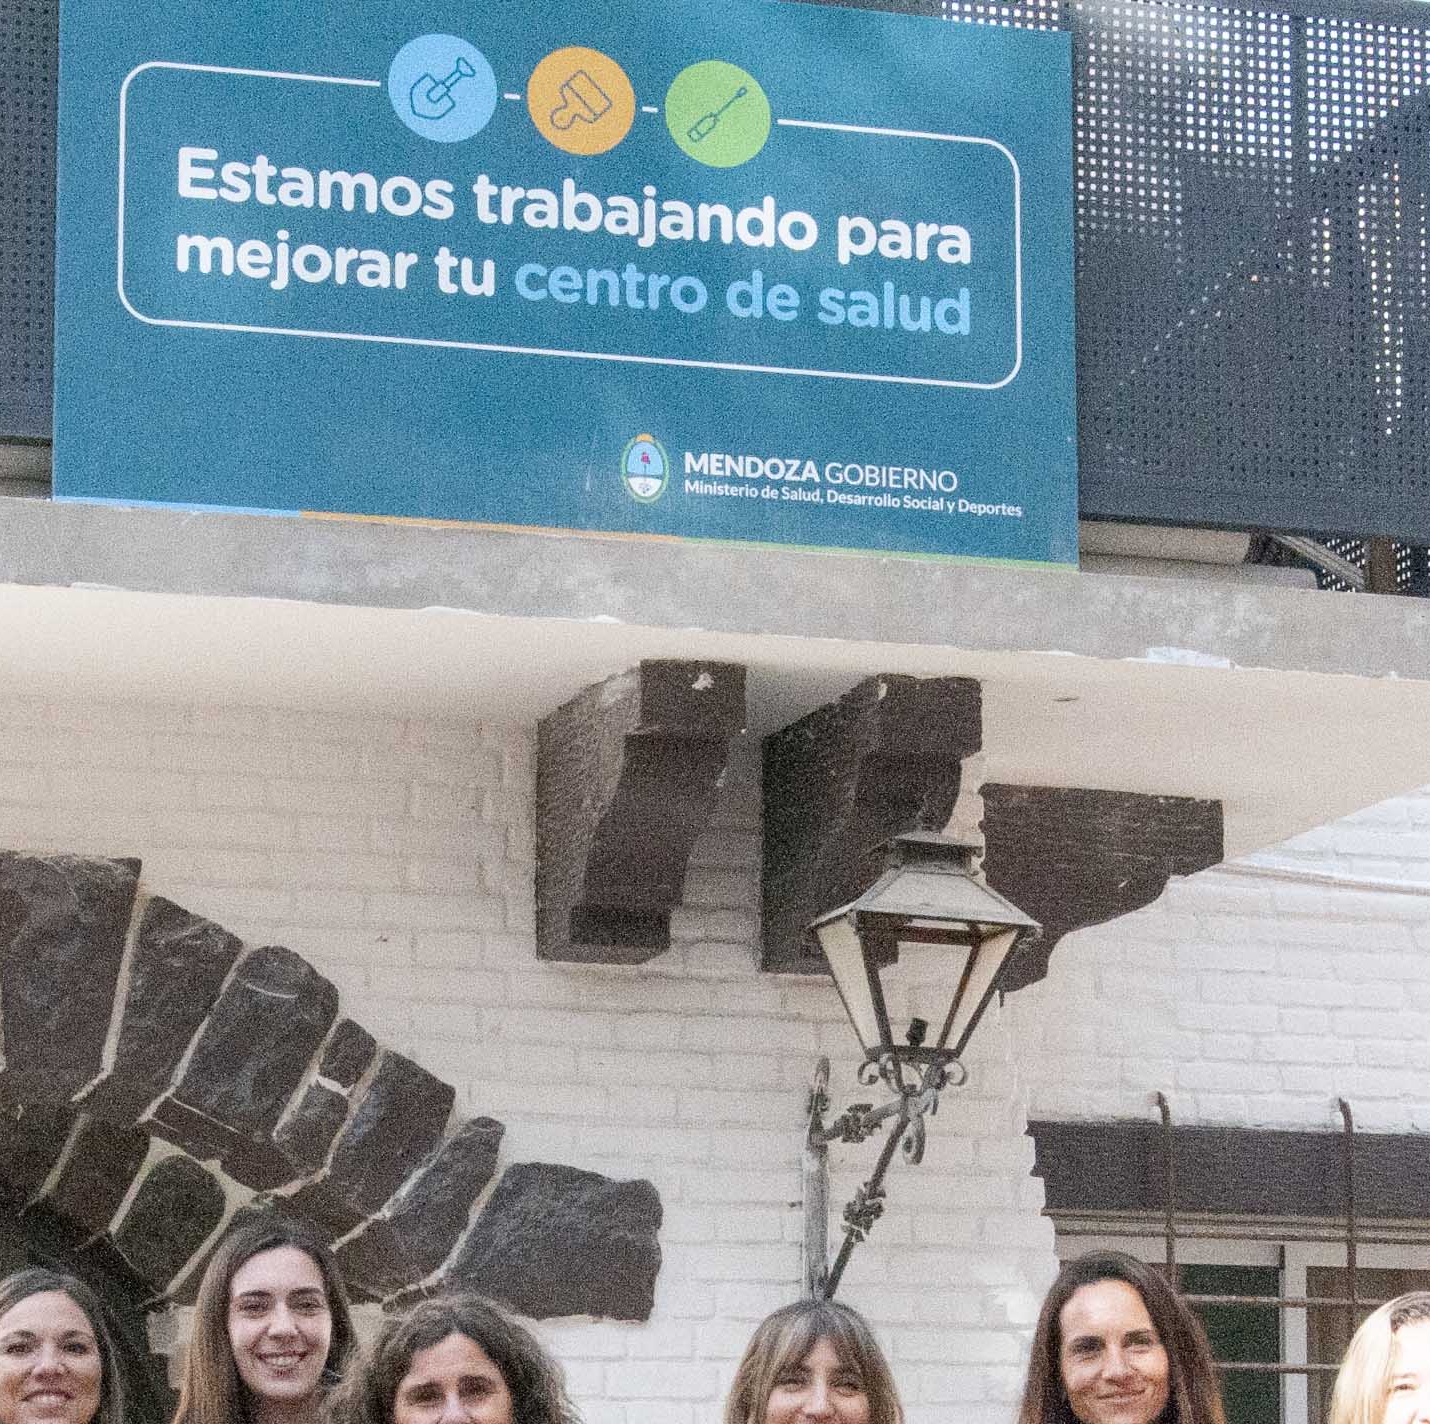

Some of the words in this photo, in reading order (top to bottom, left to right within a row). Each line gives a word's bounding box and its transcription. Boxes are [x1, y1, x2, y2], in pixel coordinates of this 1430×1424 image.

[177, 146, 455, 220] Estamos
[473, 174, 819, 248] trabajando
[837, 215, 972, 265] para
[176, 229, 418, 290] mejorar
[435, 246, 495, 297] tu
[515, 263, 708, 314] centro
[726, 269, 800, 321] de
[817, 281, 972, 336] salud
[684, 452, 821, 483] MENDOZA
[824, 462, 958, 492] GOBIERNO
[684, 479, 759, 498] Ministerio
[761, 485, 779, 500] de
[781, 487, 824, 504] Salud,
[826, 489, 901, 508] Desarrollo
[903, 494, 944, 512] Social
[946, 500, 956, 517] y
[958, 499, 1023, 518] Deportes
